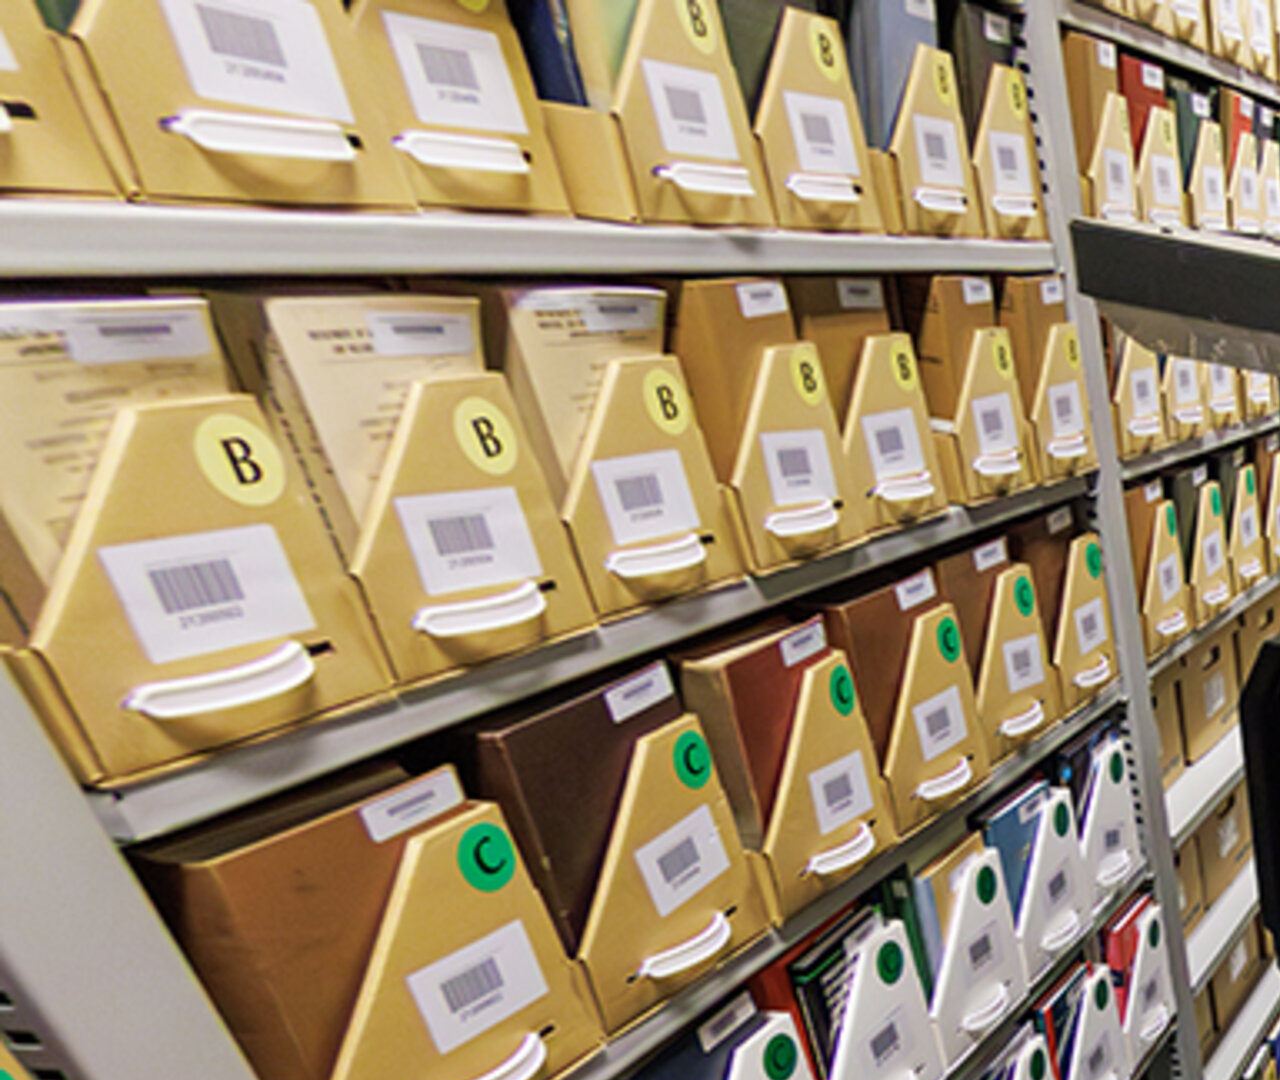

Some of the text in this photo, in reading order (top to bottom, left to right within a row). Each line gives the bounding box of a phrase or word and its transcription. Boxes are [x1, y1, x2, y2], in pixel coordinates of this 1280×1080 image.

[799, 362, 817, 393] B
[656, 386, 679, 420] B
[472, 418, 502, 458] B
[222, 438, 262, 485] B
[942, 627, 957, 654] C
[836, 676, 853, 706] C
[683, 743, 706, 776] C
[473, 836, 506, 875] C
